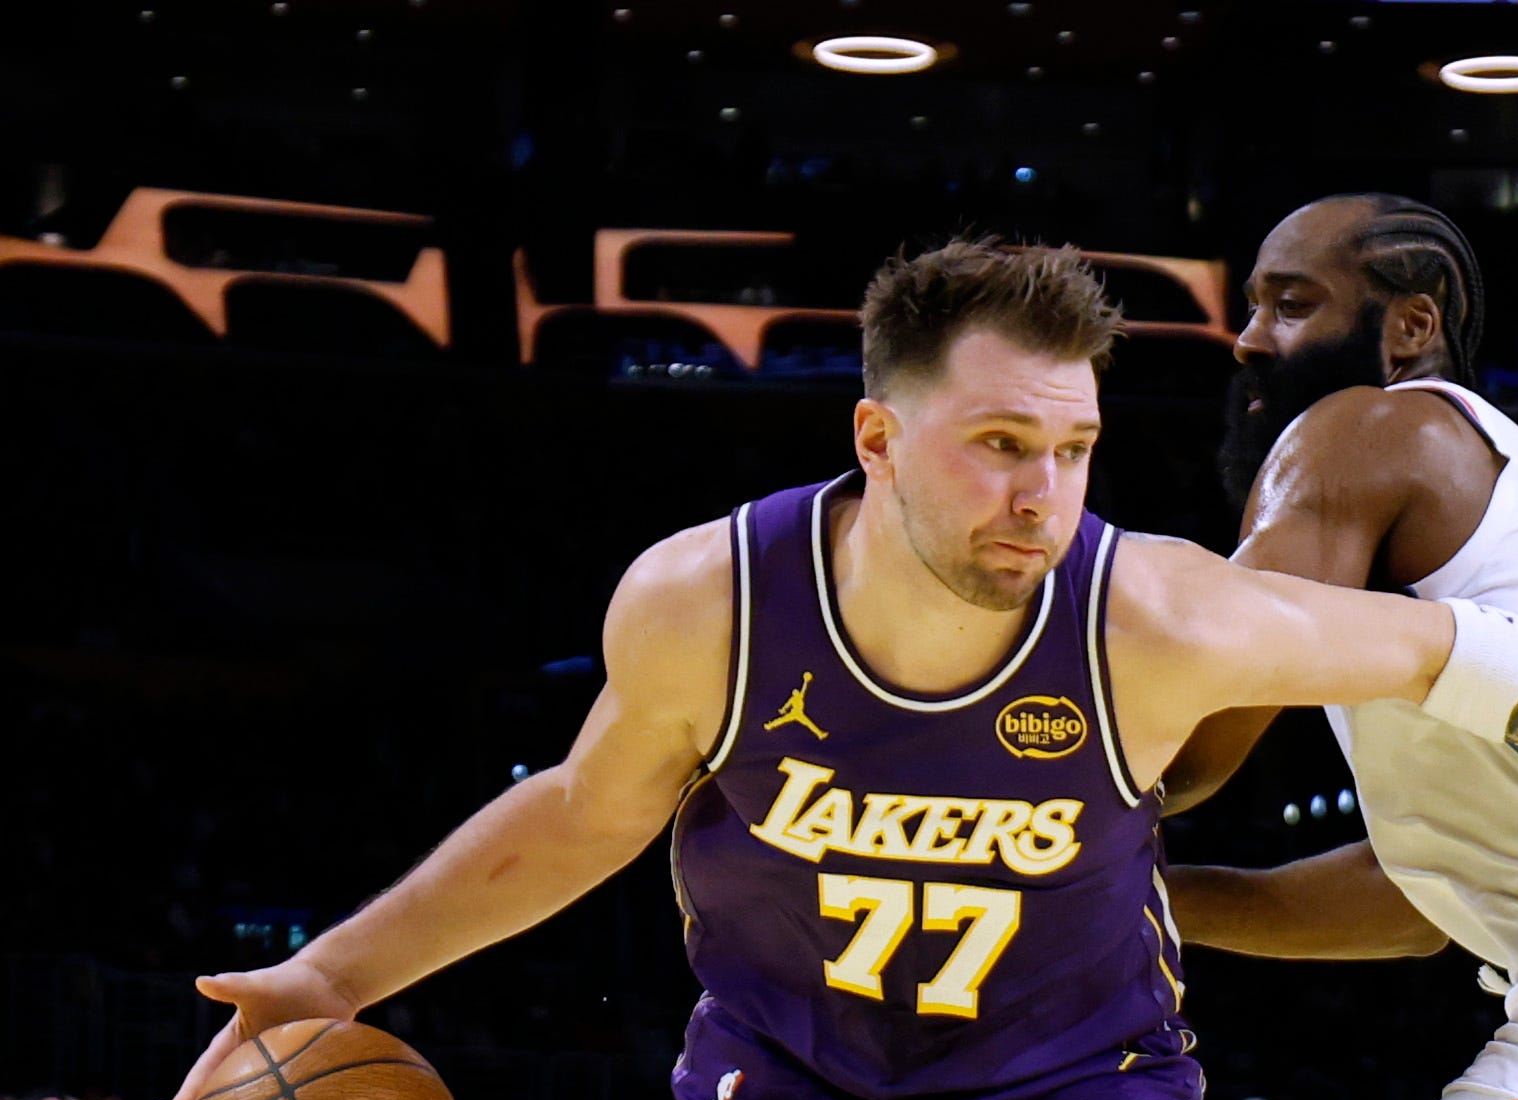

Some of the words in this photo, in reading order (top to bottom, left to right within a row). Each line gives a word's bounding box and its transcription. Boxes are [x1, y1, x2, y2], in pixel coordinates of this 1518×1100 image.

[1004, 711, 1081, 741] bibigo
[749, 756, 1085, 875] LAKERS
[817, 872, 1023, 1020] 77
